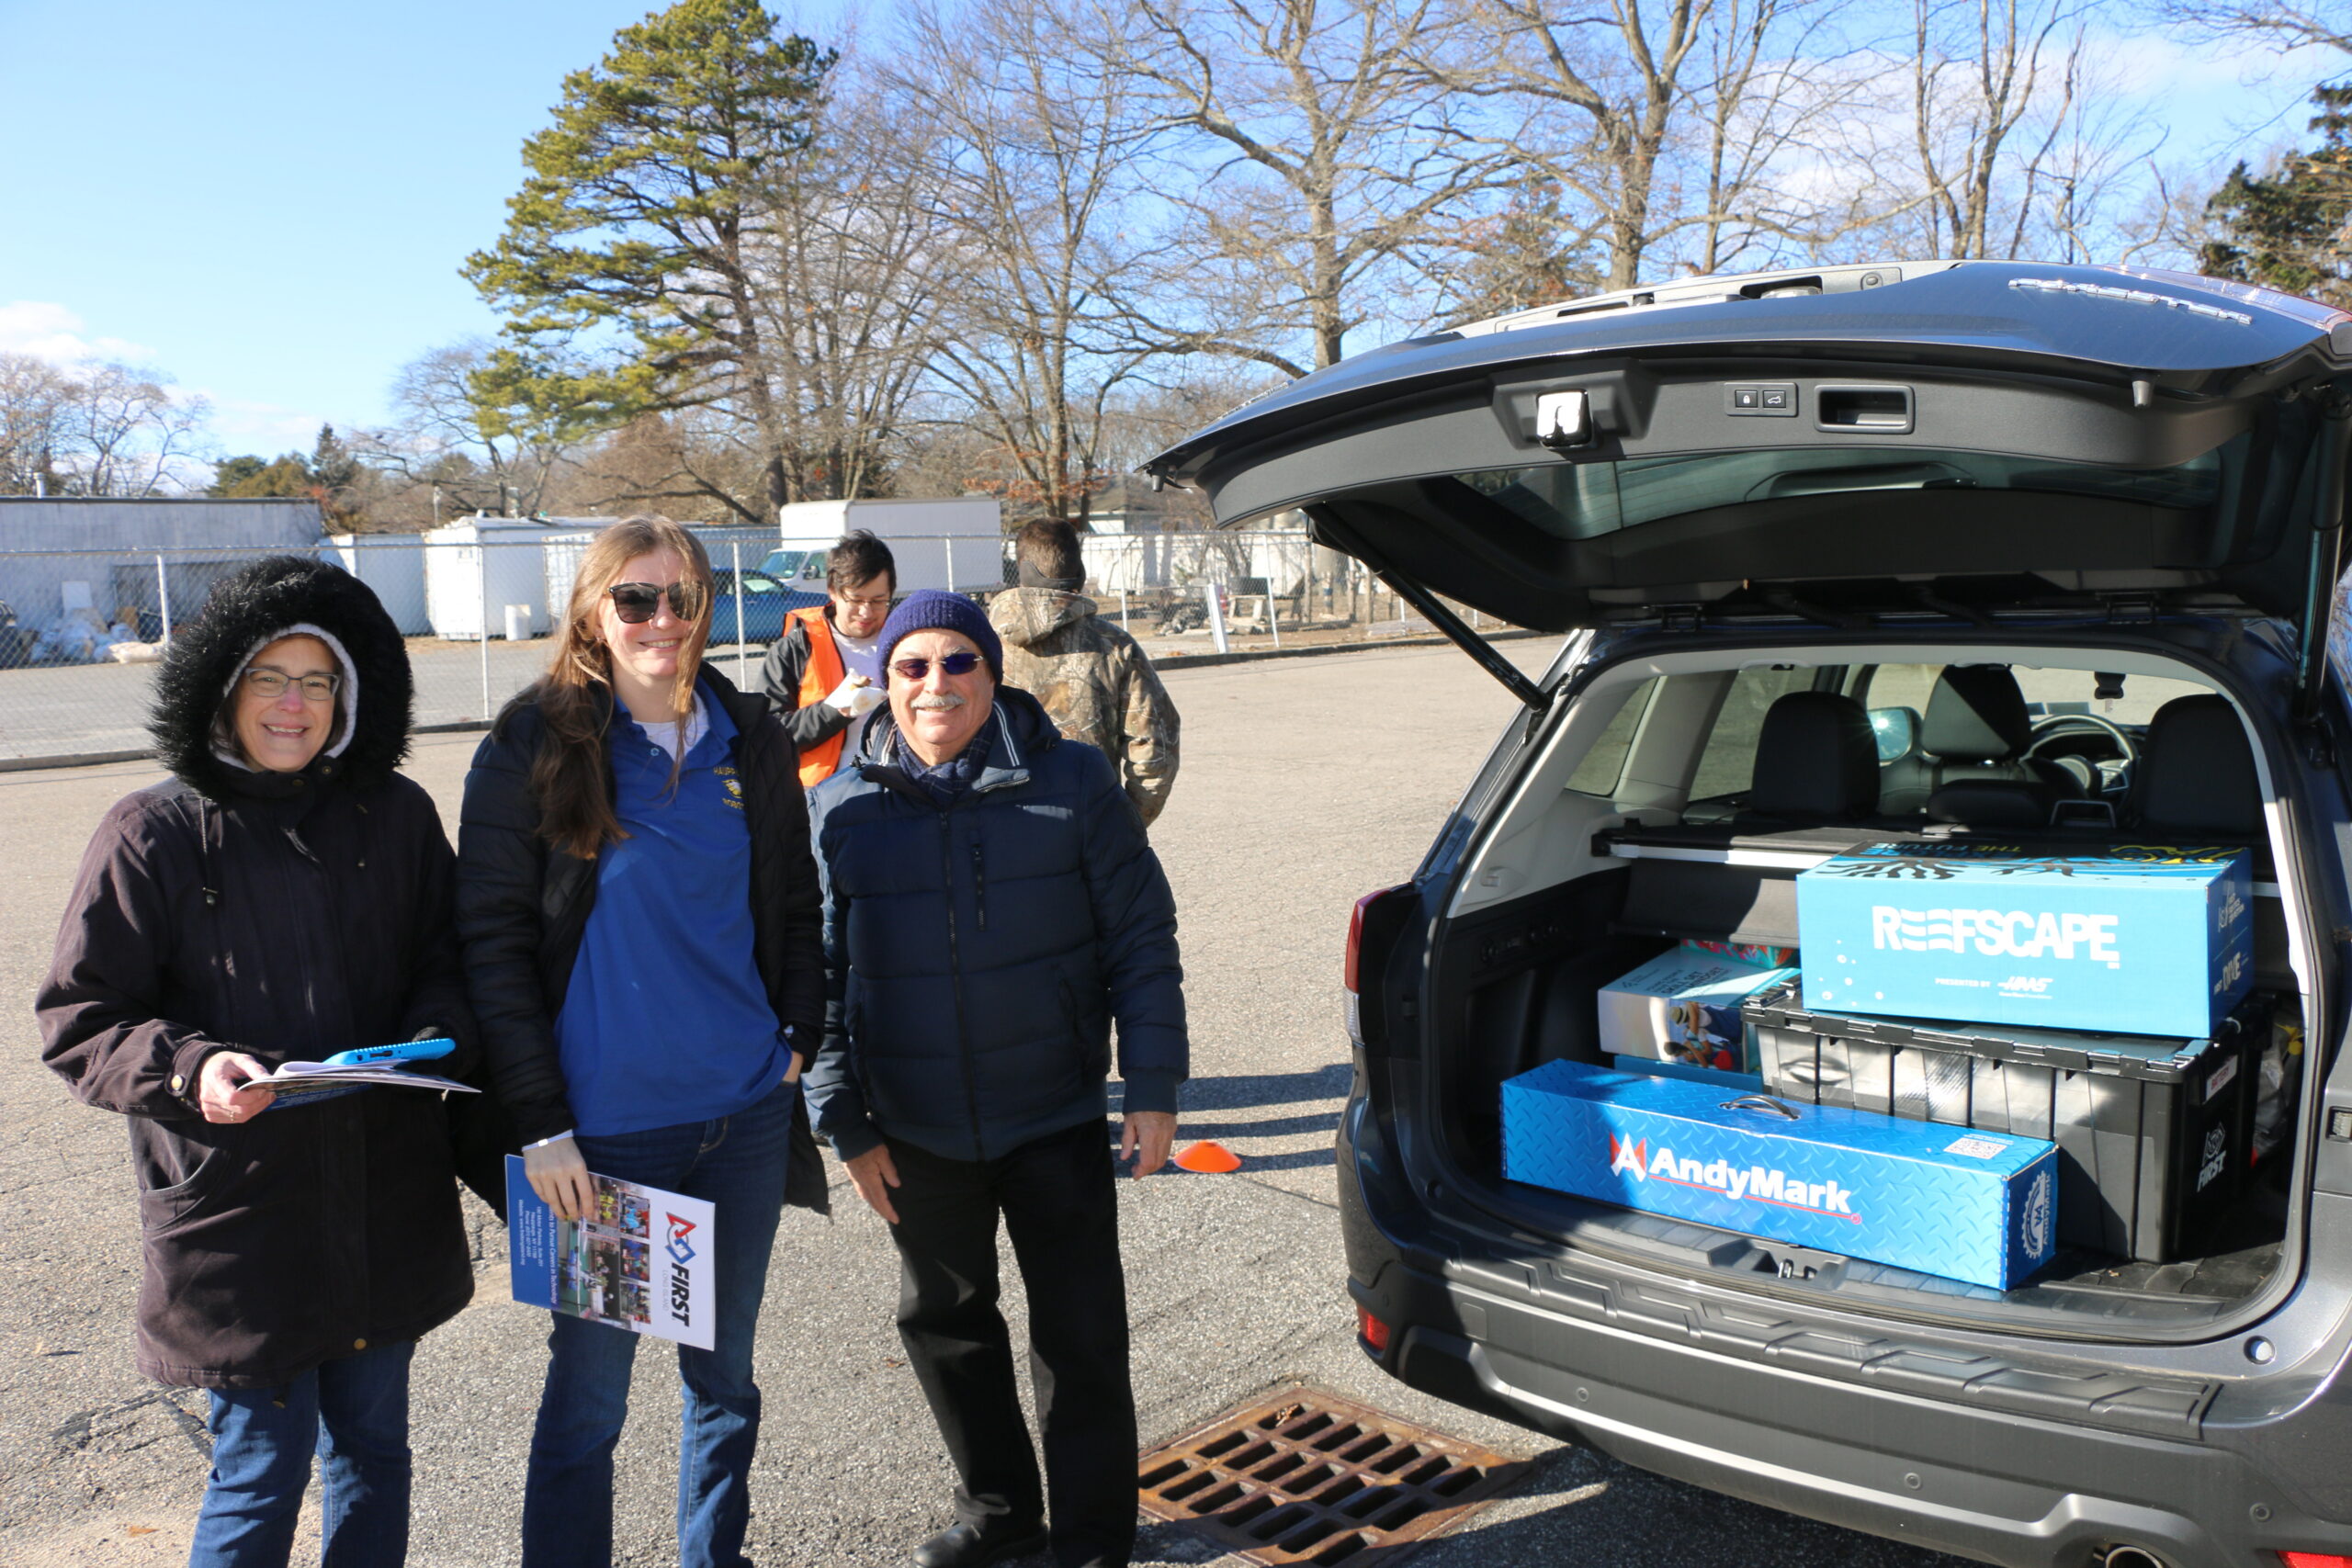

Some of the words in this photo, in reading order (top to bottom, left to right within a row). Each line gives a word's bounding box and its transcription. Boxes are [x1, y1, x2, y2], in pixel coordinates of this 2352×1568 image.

[1871, 906, 2120, 963] REEFSCAPE
[1648, 1147, 1852, 1213] AndyMark
[2197, 1150, 2227, 1193] FIRST
[671, 1262, 690, 1327] FIRST
